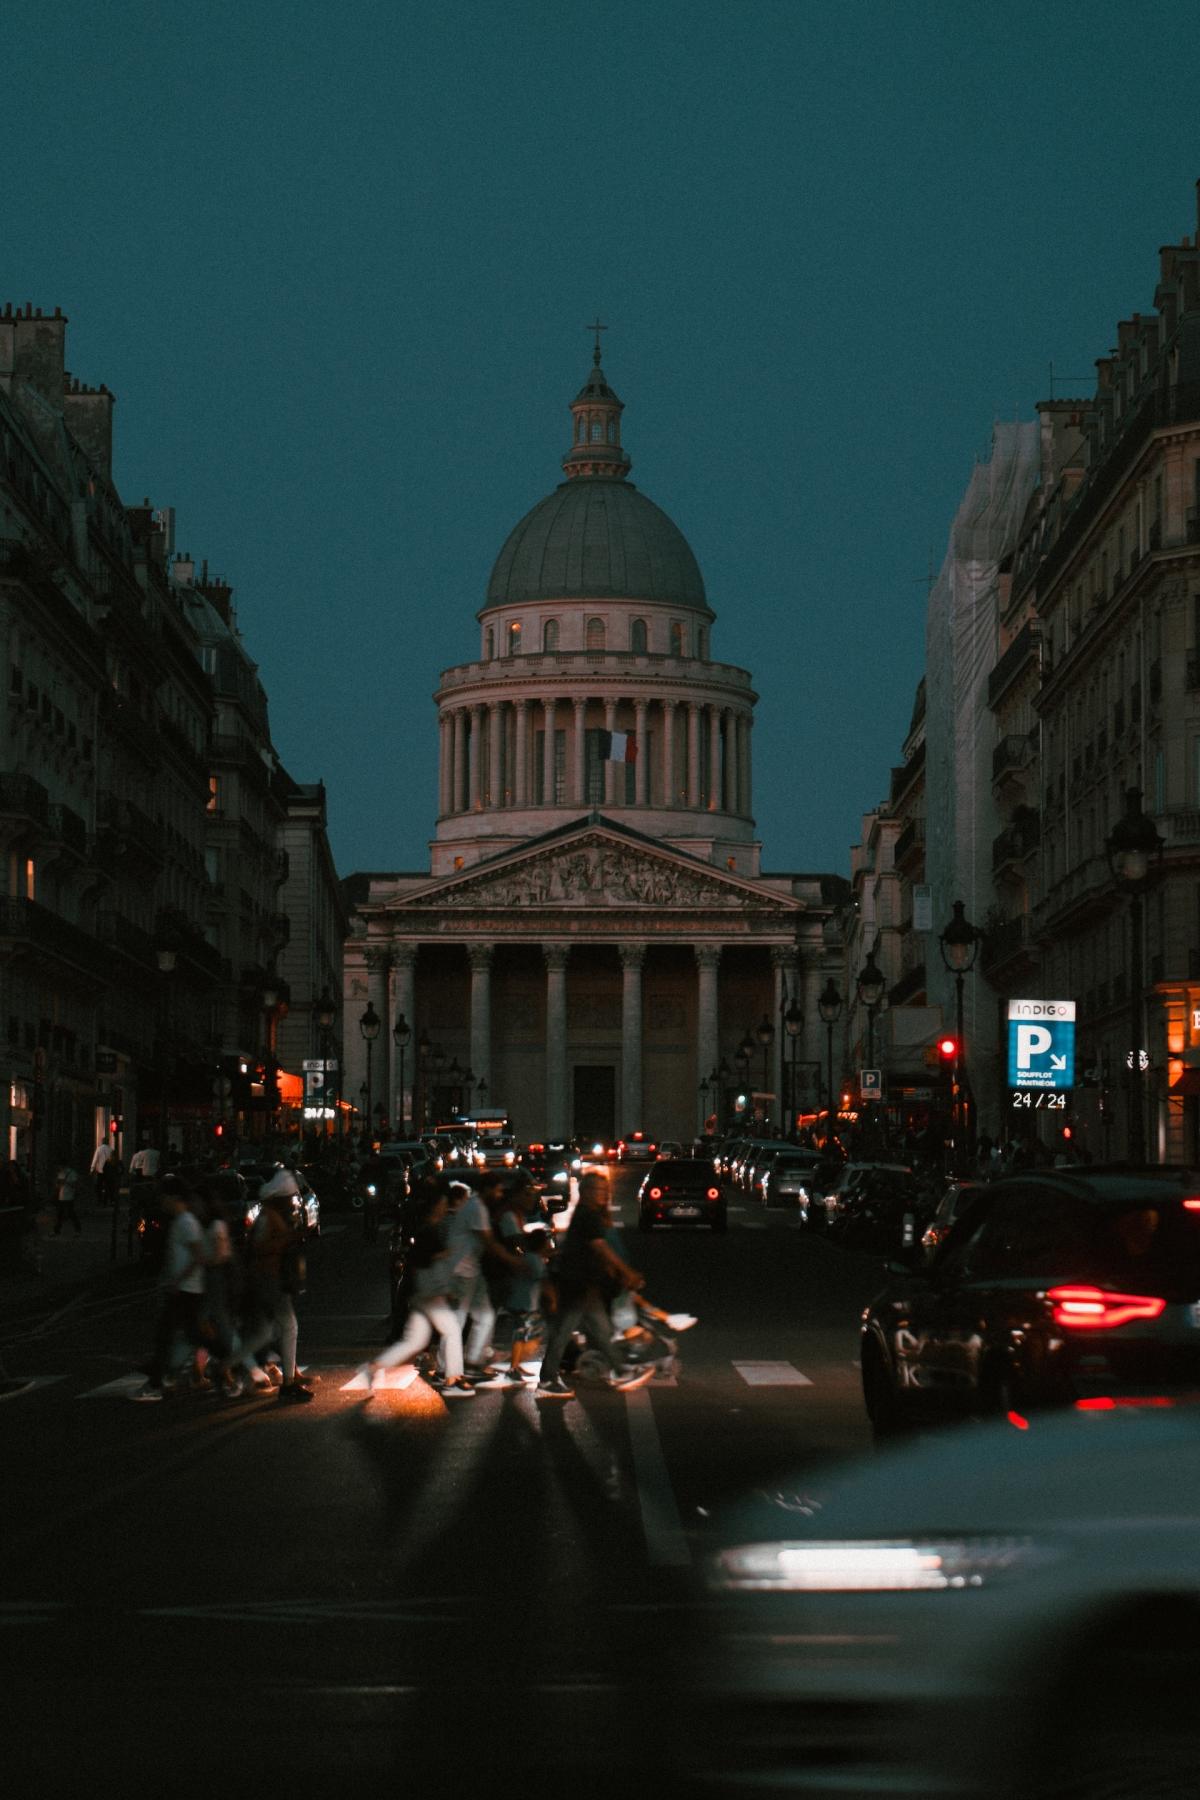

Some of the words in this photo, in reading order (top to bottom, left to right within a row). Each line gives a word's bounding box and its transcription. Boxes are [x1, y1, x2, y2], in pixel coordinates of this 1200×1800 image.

[1017, 1024, 1052, 1069] P
[306, 1072, 324, 1096] P
[866, 1074, 875, 1086] P
[1013, 1092, 1031, 1108] 24
[1047, 1093, 1066, 1109] 24
